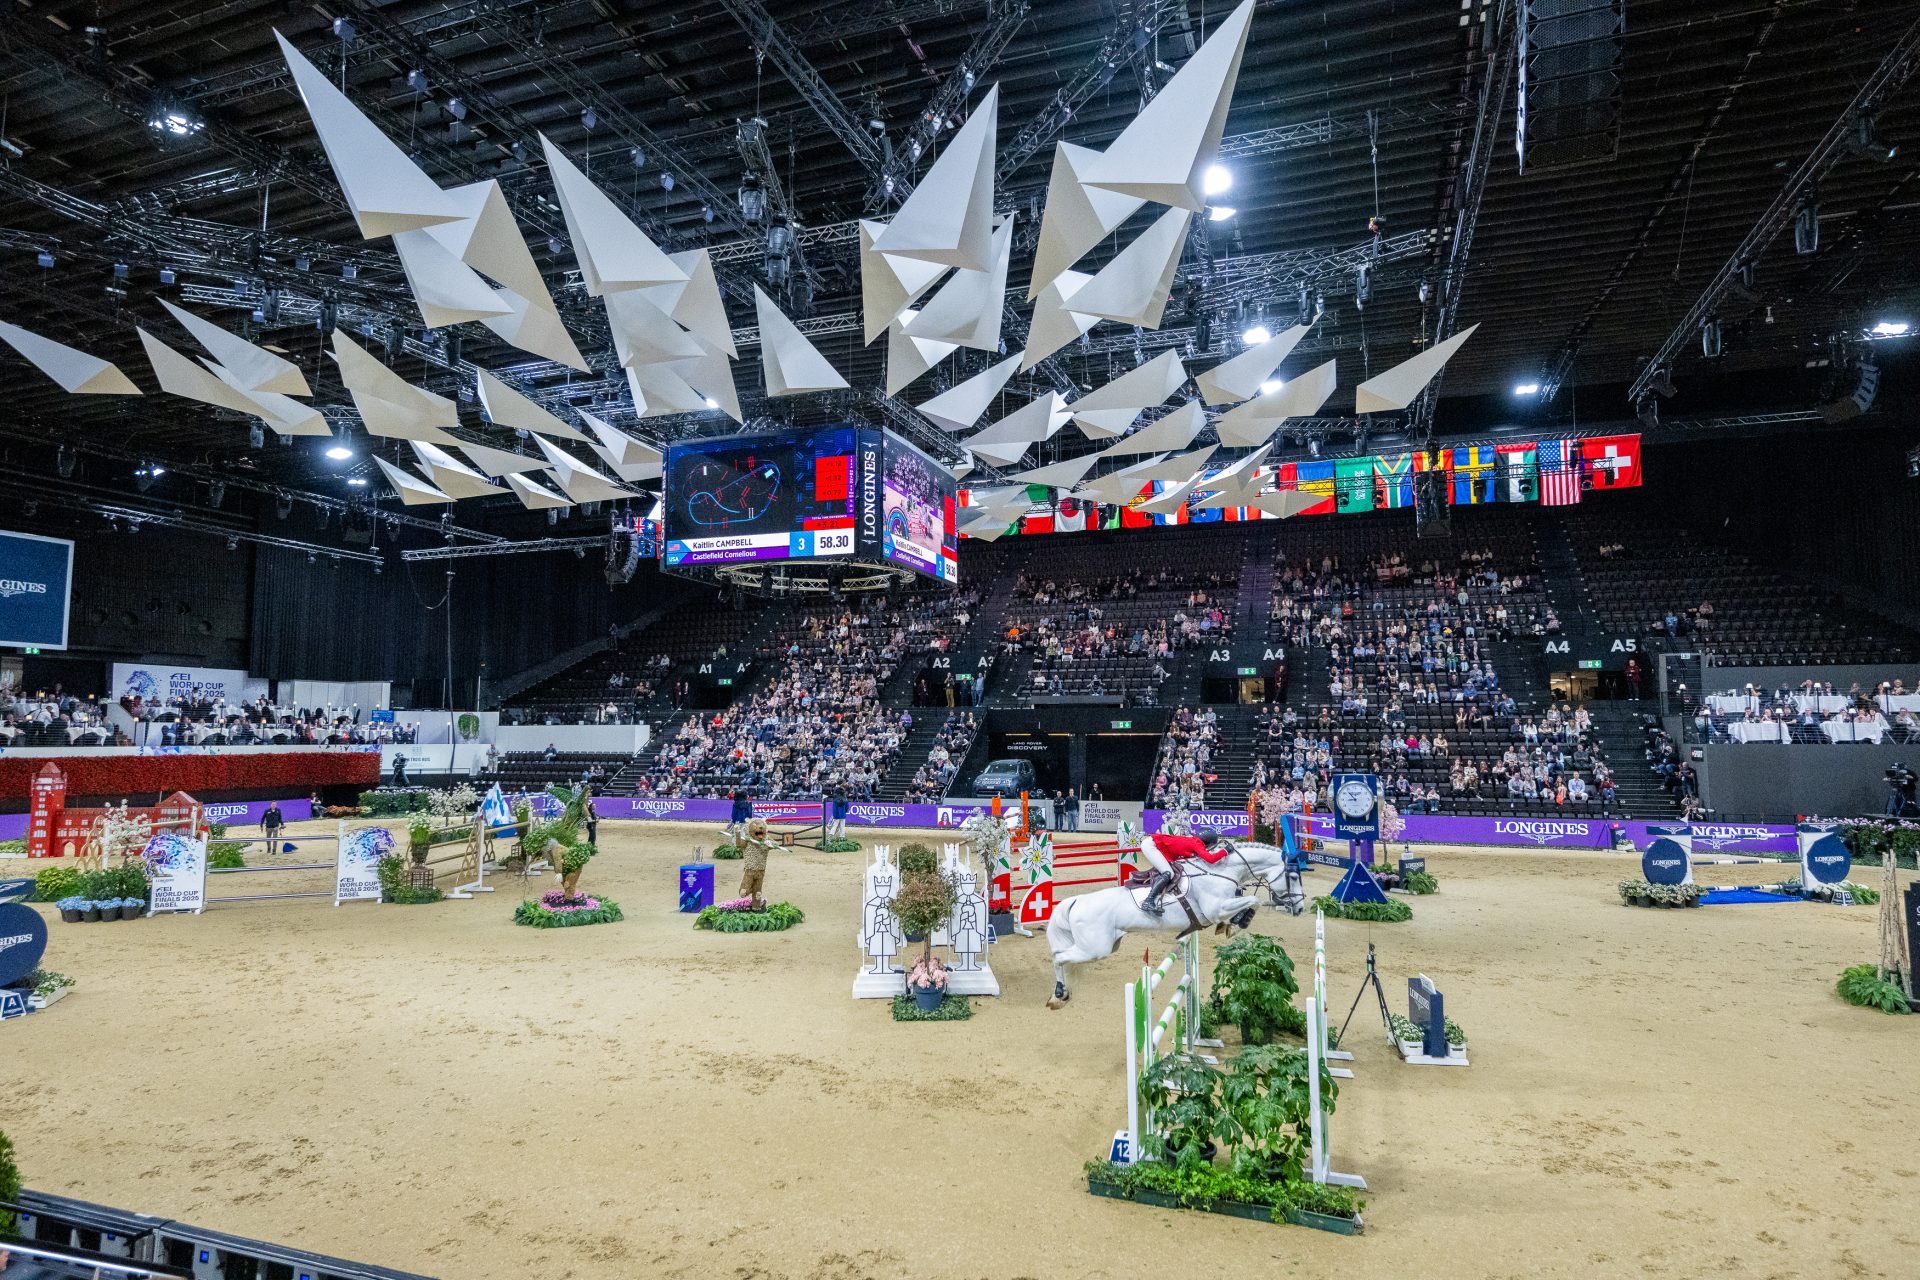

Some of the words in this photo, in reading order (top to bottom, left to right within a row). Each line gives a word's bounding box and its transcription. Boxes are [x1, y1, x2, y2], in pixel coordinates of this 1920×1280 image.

[864, 451, 876, 536] LONGINES
[716, 538, 752, 548] CAMPBELL
[798, 538, 805, 550] 3
[820, 535, 848, 548] 58.30
[692, 552, 724, 560] Castlefield
[0, 580, 46, 594] GINES
[1545, 640, 1570, 654] A4
[1610, 639, 1637, 652] A5
[1210, 650, 1230, 662] A3
[1262, 648, 1284, 660] A4
[932, 657, 950, 668] A2
[698, 664, 712, 674] A1
[170, 680, 203, 689] WORLD
[170, 688, 202, 698] FINAS
[204, 690, 225, 698] 2025
[632, 800, 685, 810] LONGINES
[846, 805, 904, 816] ONGINES
[1190, 814, 1249, 826] ONGINE
[1495, 821, 1588, 835] LONGINES
[1692, 826, 1768, 840] NGINES
[1308, 854, 1324, 863] BASEL
[1326, 856, 1339, 866] 2025
[0, 934, 32, 945] INES
[8, 997, 16, 1007] A
[1117, 1142, 1129, 1158] 12
